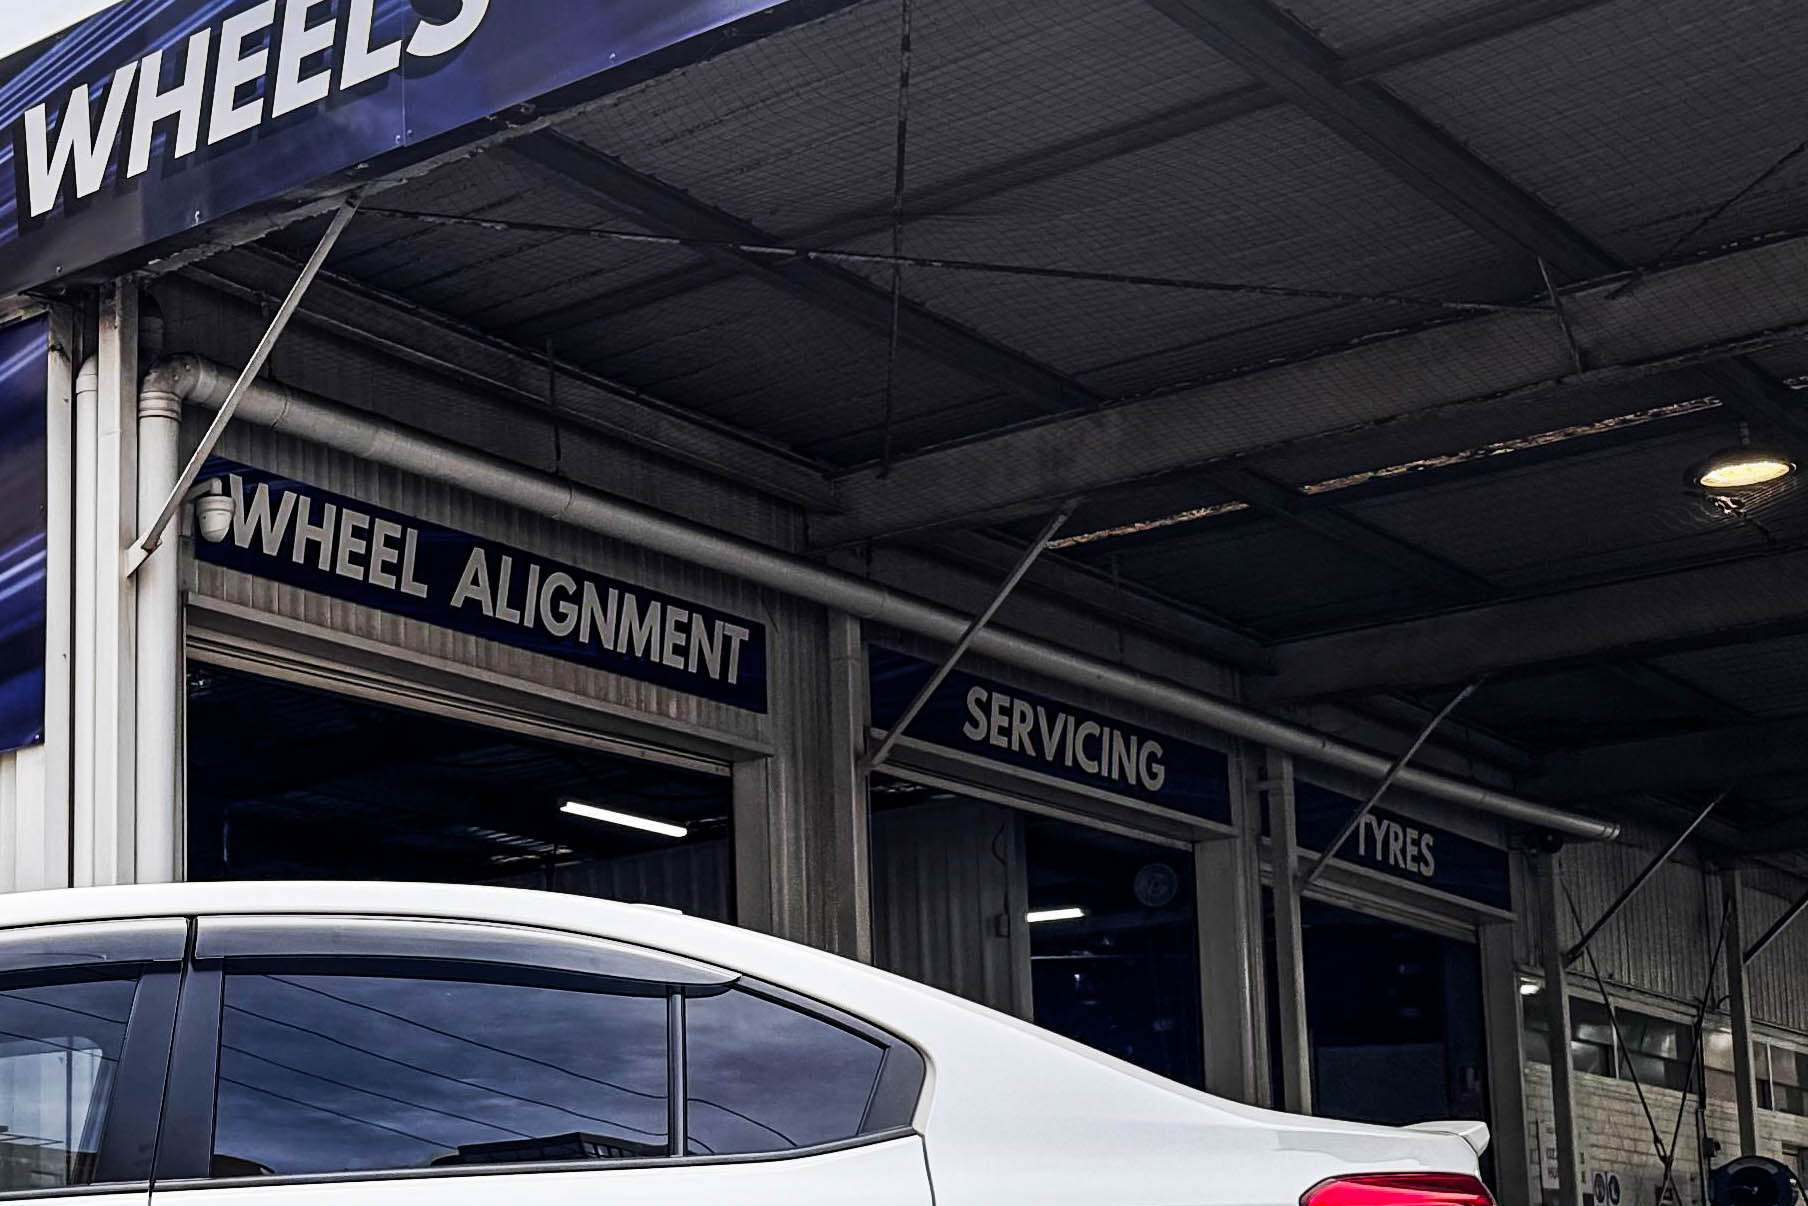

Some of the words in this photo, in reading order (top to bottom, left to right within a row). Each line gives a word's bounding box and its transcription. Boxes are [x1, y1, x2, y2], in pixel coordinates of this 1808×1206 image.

[229, 473, 428, 598] WHEEL
[450, 547, 749, 685] ALIGNMENT
[963, 686, 1165, 791] SERVICING
[1357, 813, 1435, 876] TYRES
